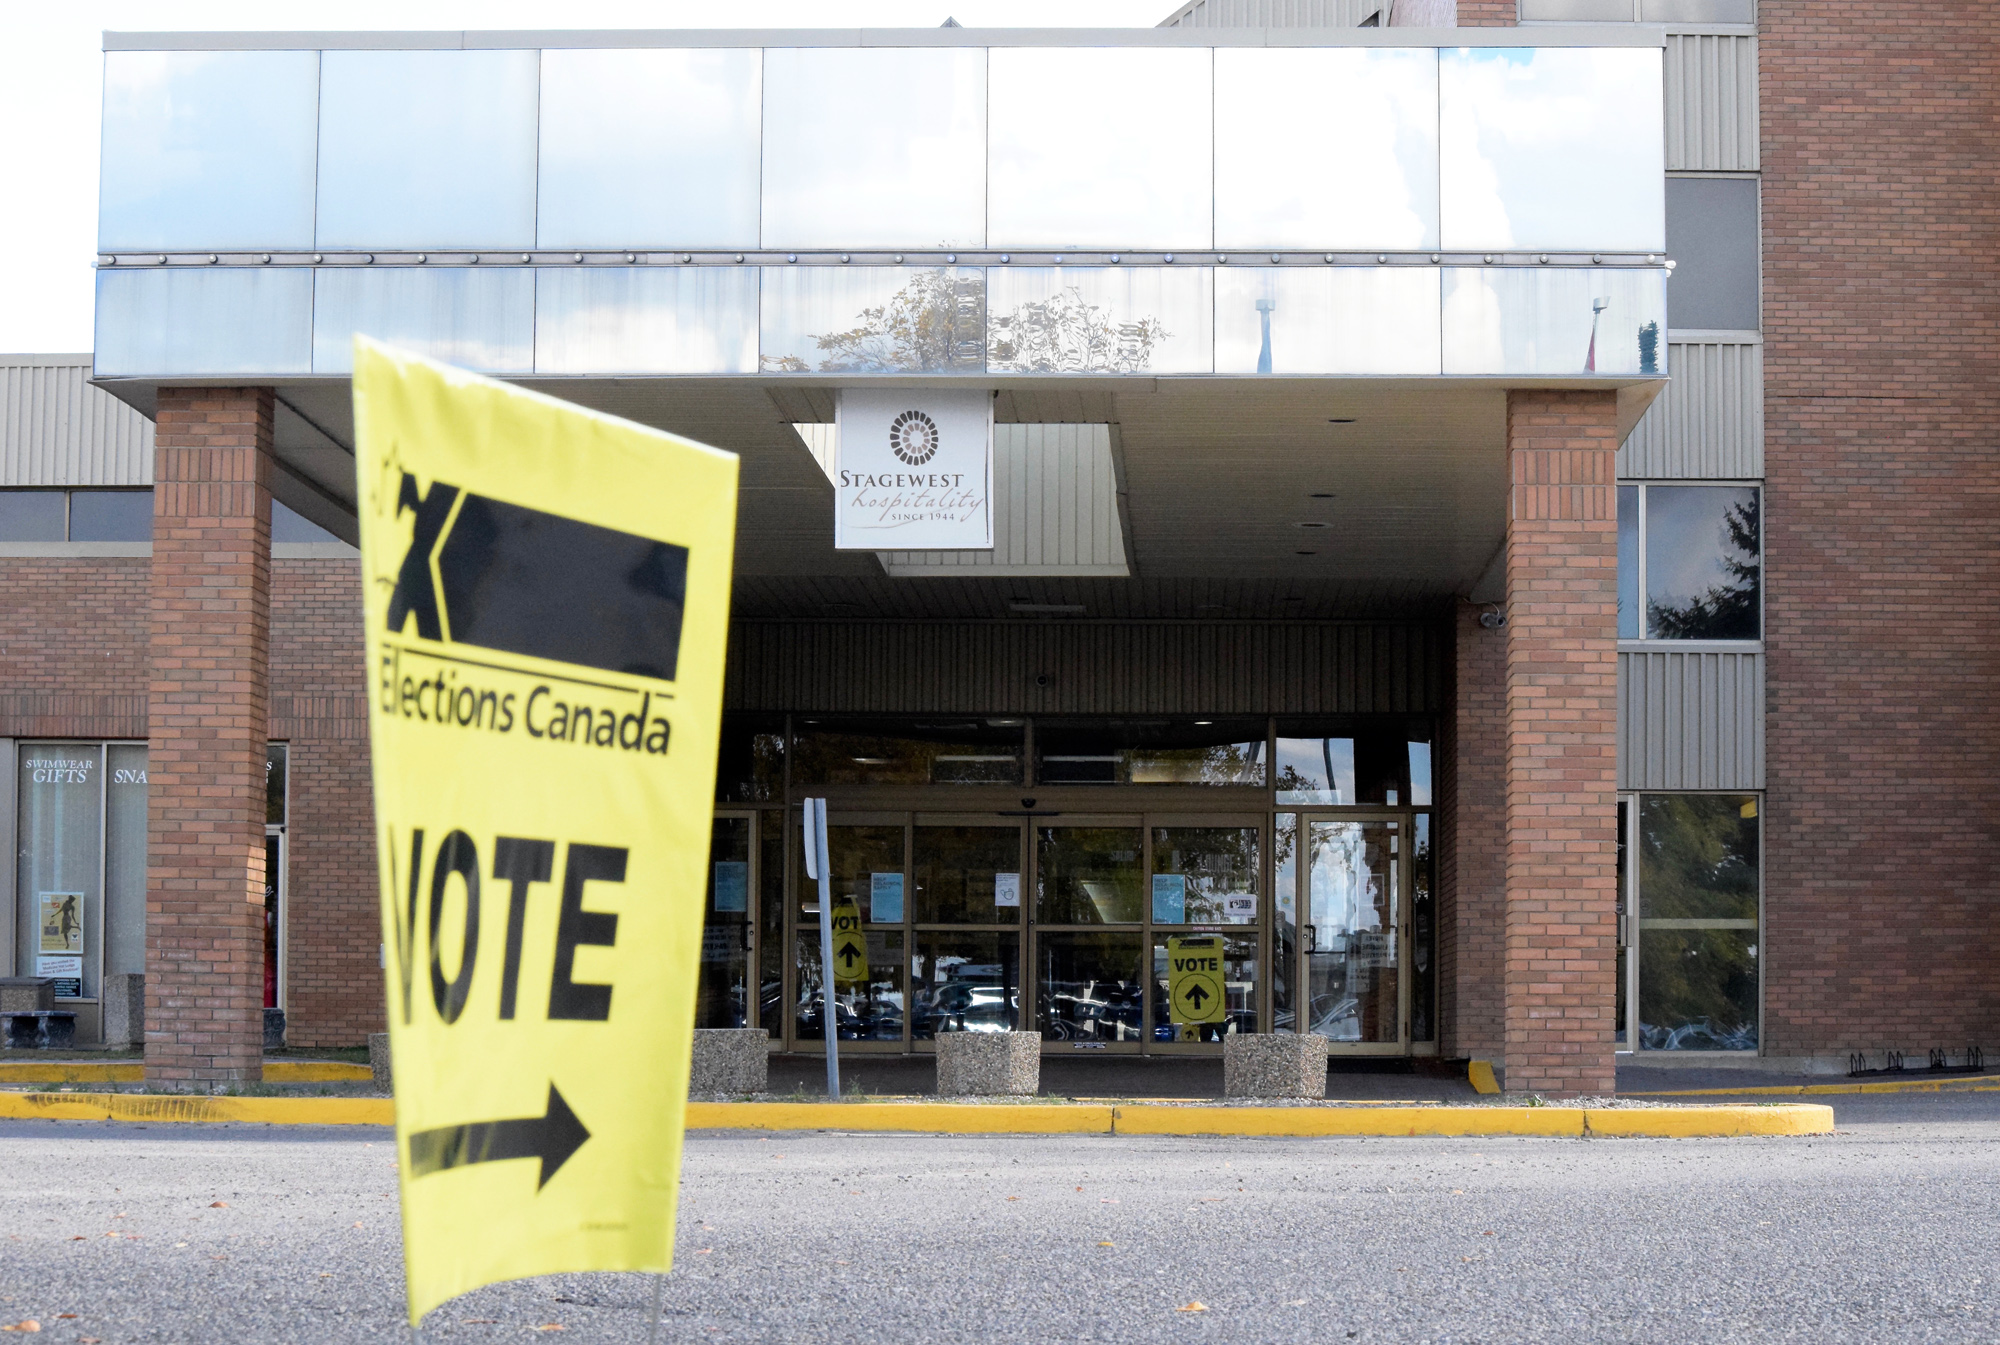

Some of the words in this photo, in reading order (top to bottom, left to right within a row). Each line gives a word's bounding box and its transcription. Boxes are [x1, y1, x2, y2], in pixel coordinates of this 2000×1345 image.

[840, 469, 965, 488] STAGEWEST
[851, 488, 985, 523] hospitality
[891, 513, 924, 521] SINCE
[930, 512, 955, 521] 1944
[525, 684, 672, 756] Canada
[25, 759, 93, 769] SWIMWEAR
[33, 768, 87, 784] GIFTS
[389, 823, 630, 1026] VOTE
[831, 916, 859, 930] VOT
[1174, 957, 1218, 972] VOTE
